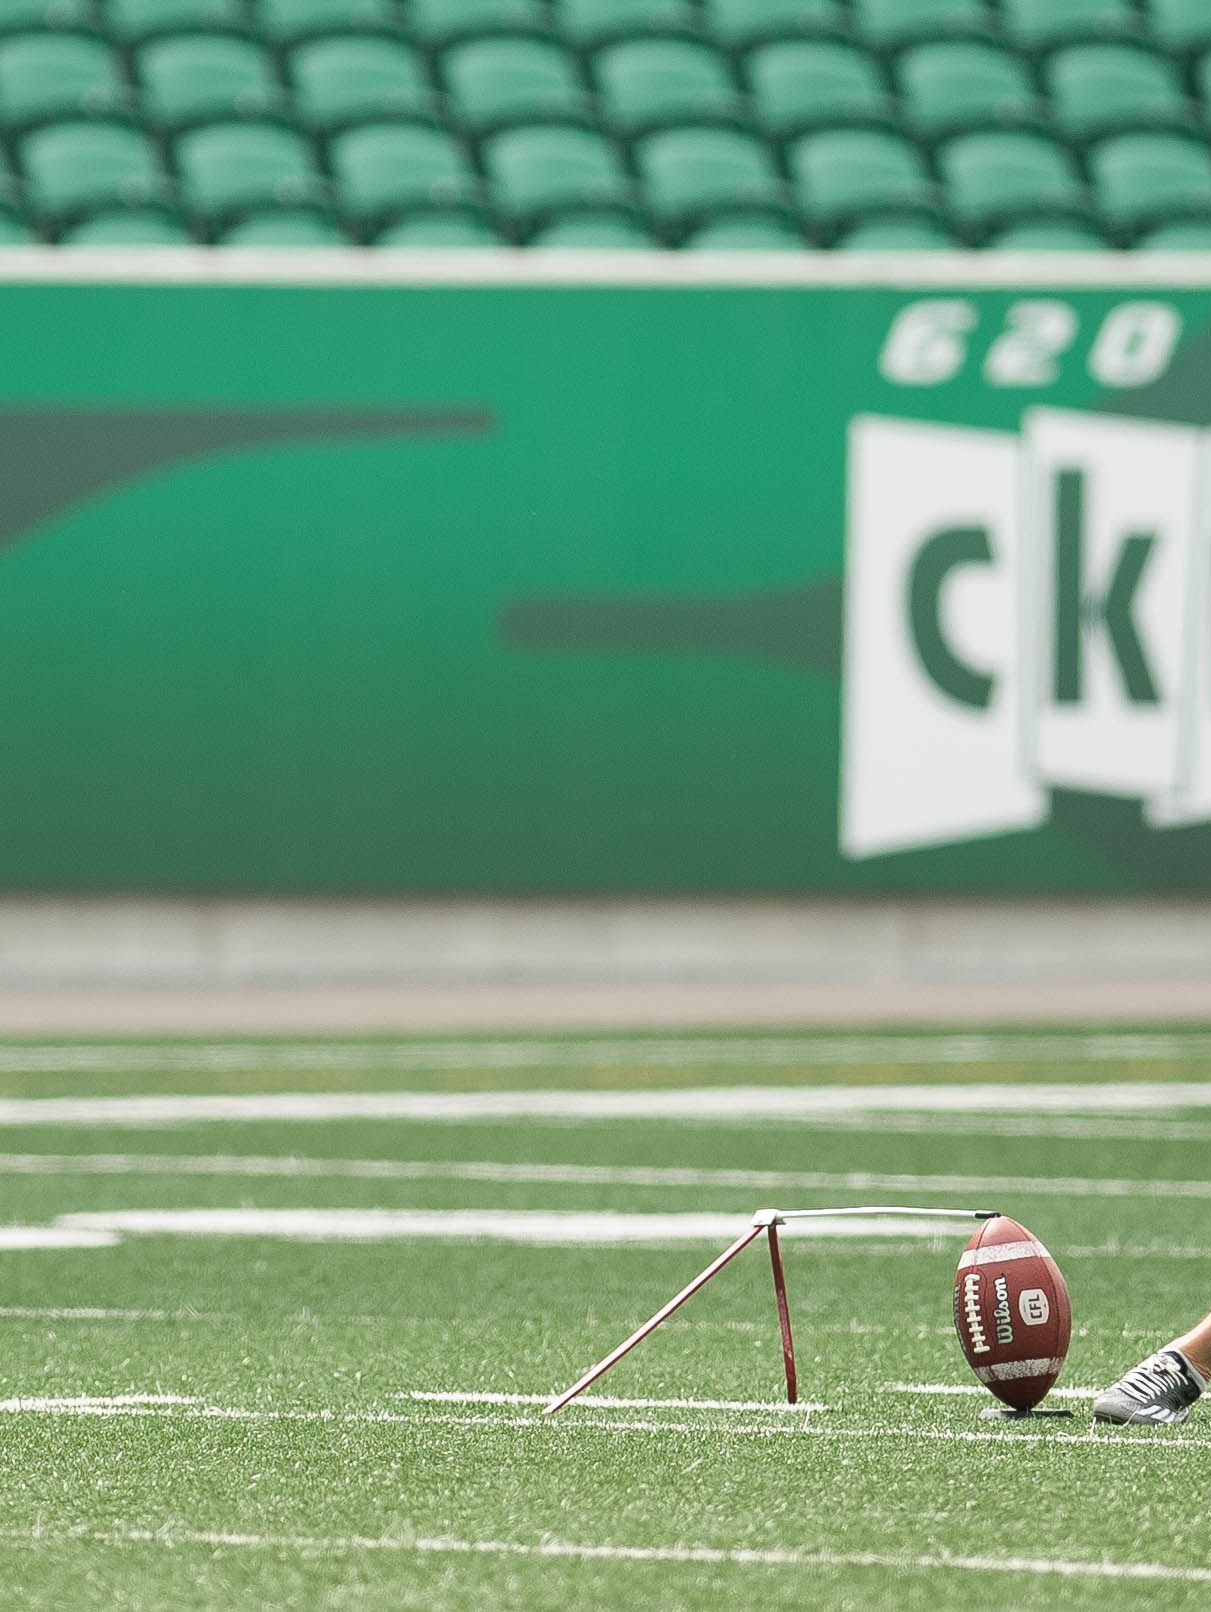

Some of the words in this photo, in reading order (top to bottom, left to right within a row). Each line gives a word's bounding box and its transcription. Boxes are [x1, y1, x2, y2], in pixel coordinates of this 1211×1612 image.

[878, 300, 1183, 387] 620
[993, 1275, 1014, 1345] Wilson
[1028, 1293, 1043, 1320] CFL
